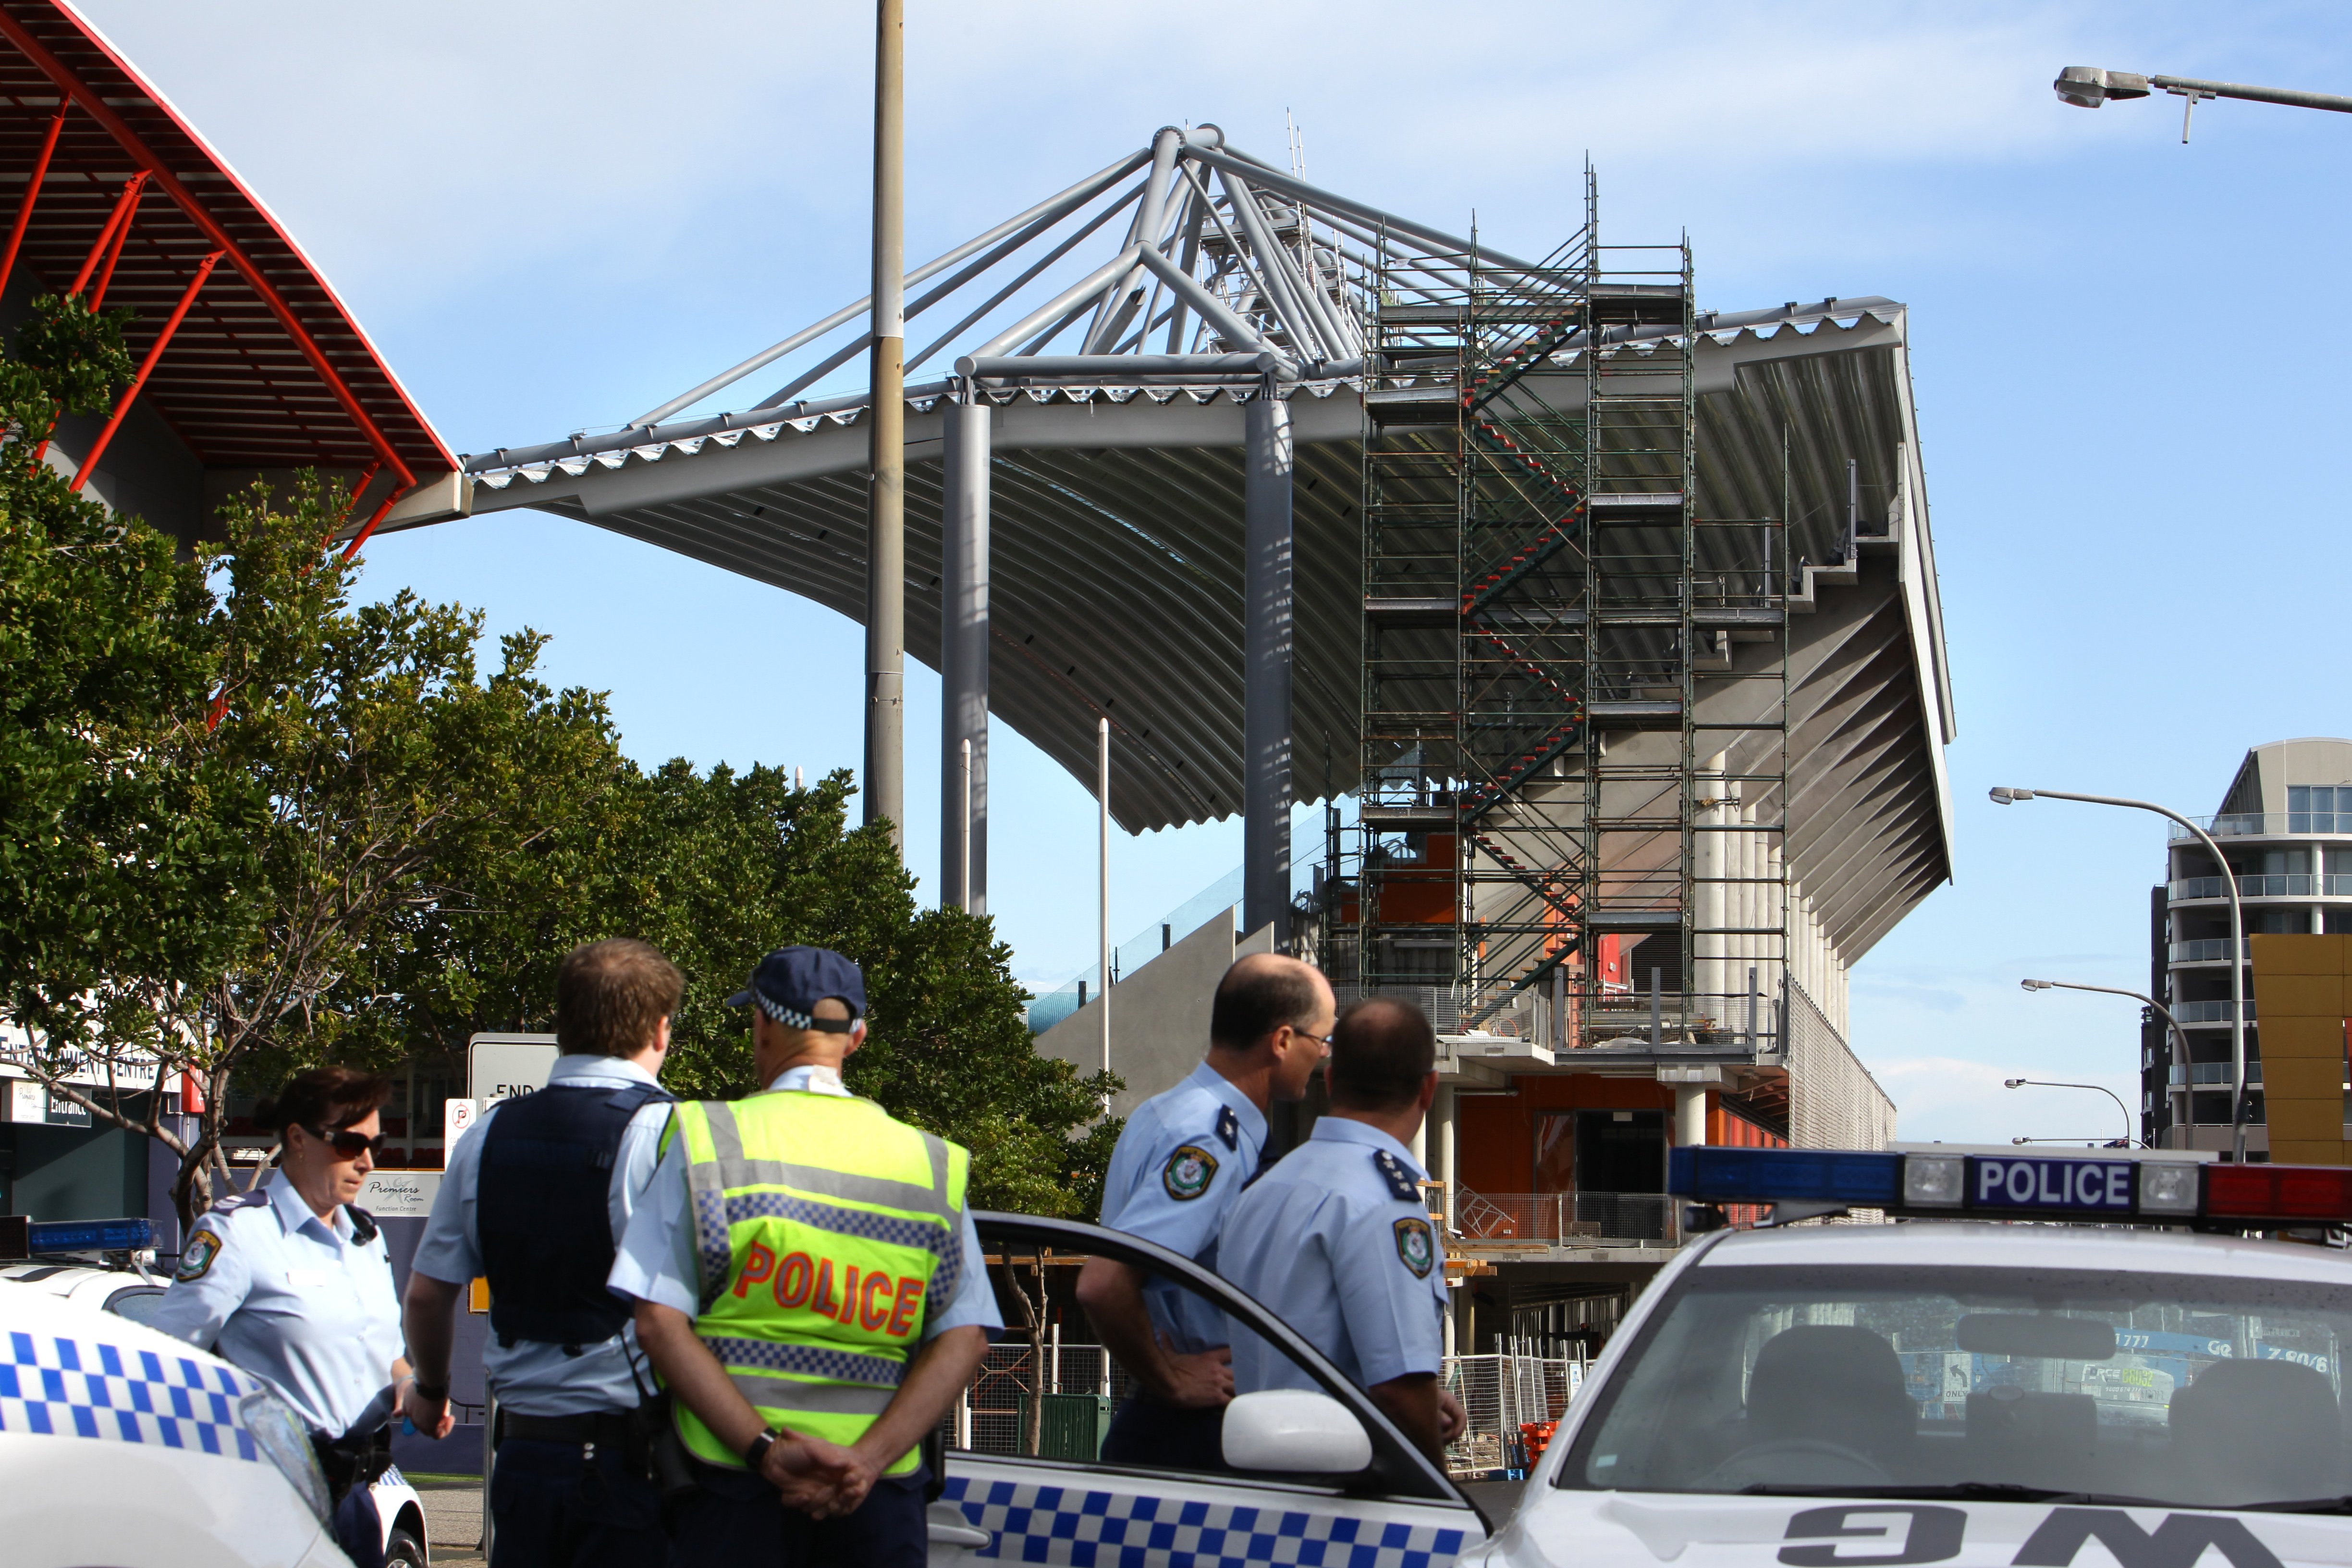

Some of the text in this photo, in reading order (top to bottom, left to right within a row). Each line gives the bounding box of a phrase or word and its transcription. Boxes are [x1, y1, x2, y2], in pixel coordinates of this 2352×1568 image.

[0, 1036, 100, 1074] ENTERTNMENT
[110, 1052, 154, 1080] ENTRE
[369, 1181, 419, 1193] Premiers
[1979, 1161, 2130, 1205] POLICE
[404, 1194, 424, 1203] Room
[733, 1240, 925, 1337] POLICE
[2123, 1335, 2149, 1348] 777
[2267, 1348, 2329, 1372] Z-80/6
